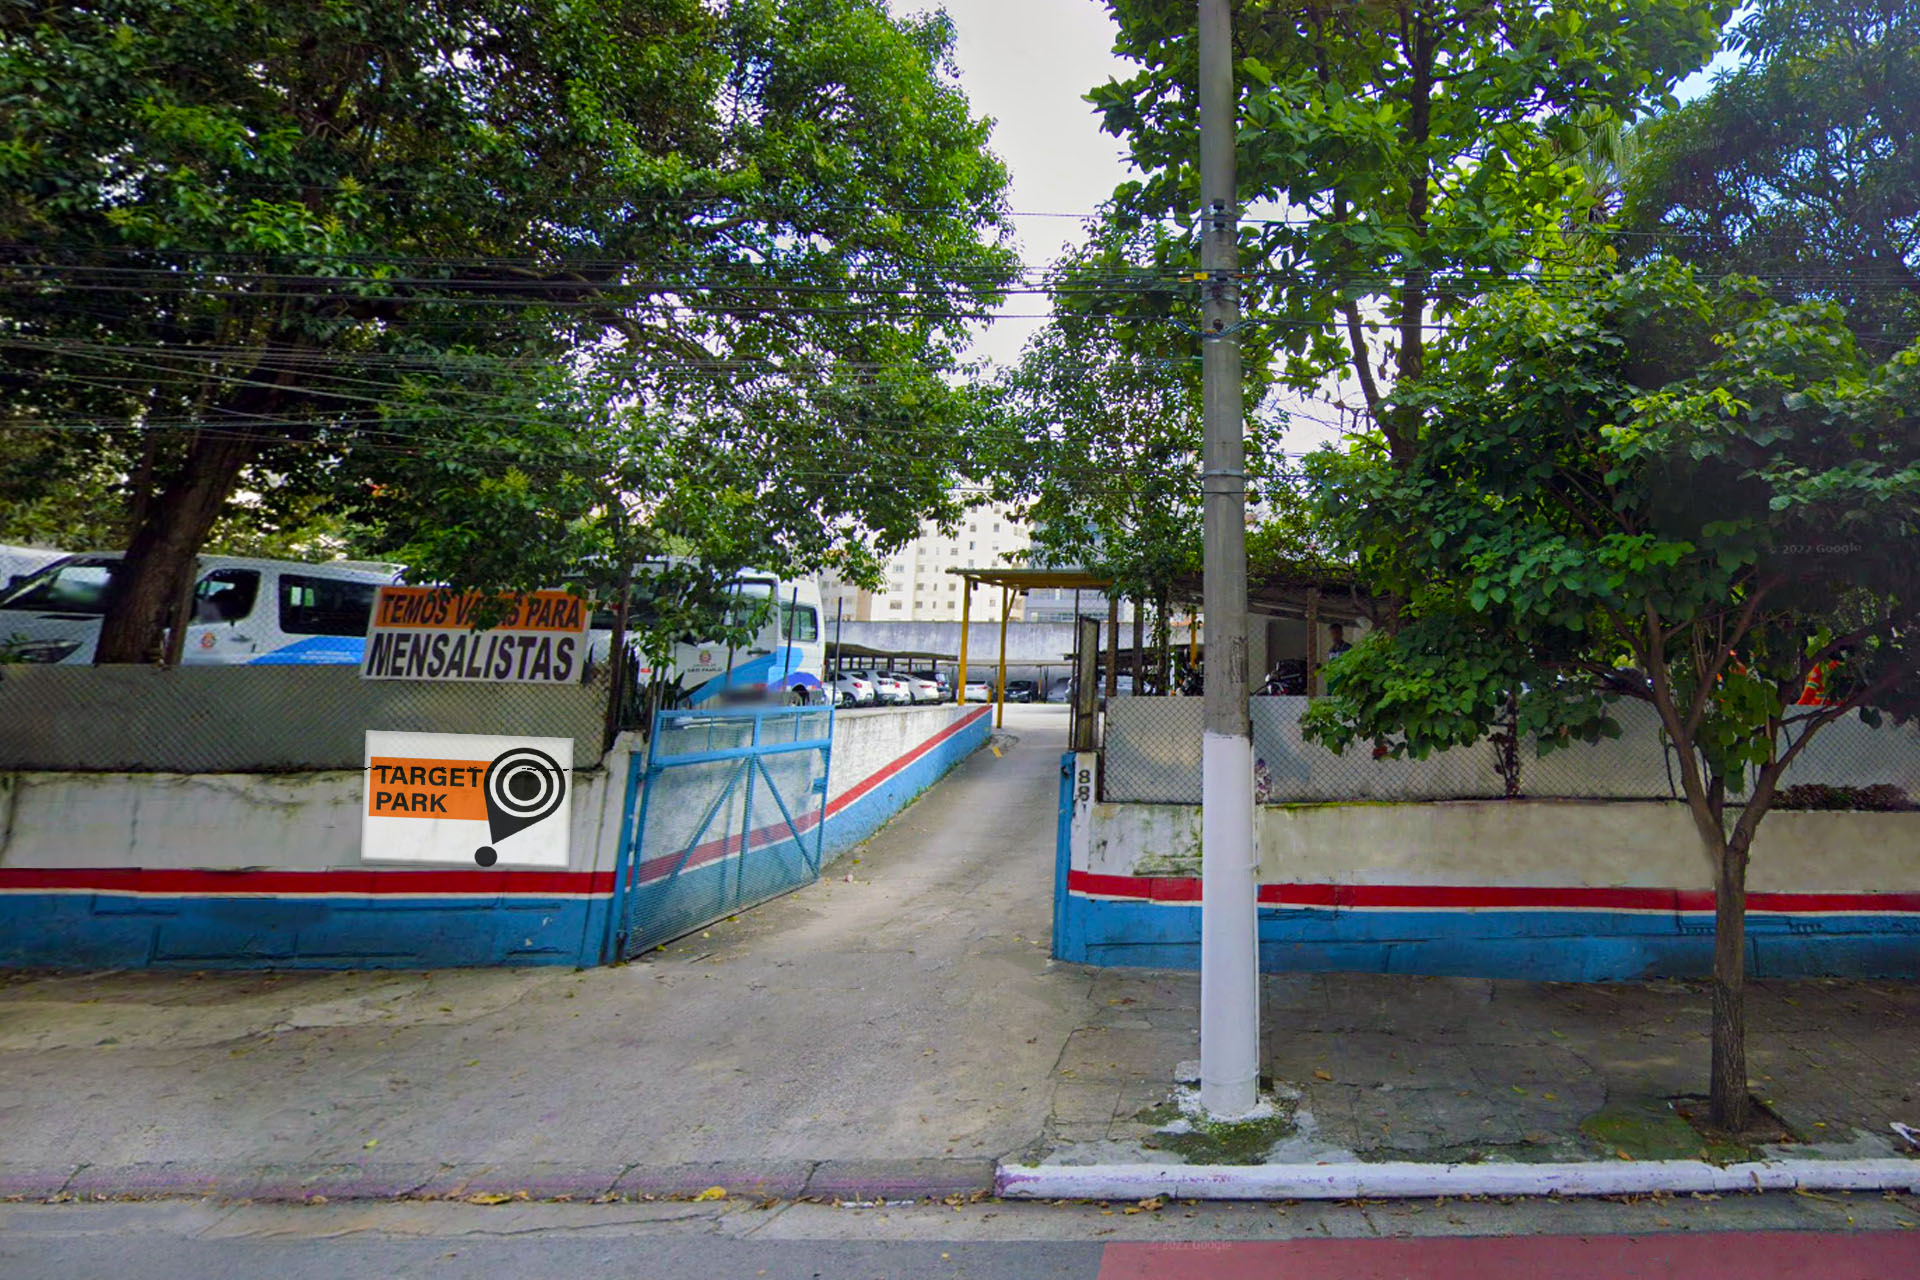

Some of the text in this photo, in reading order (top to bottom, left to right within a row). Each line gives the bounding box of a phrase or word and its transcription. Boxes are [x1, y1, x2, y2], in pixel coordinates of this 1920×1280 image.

[382, 593, 451, 625] TEMOS
[525, 597, 580, 629] PARA
[366, 632, 575, 681] MENSALISTAS
[373, 765, 484, 788] TARGET
[376, 791, 448, 813] PARK
